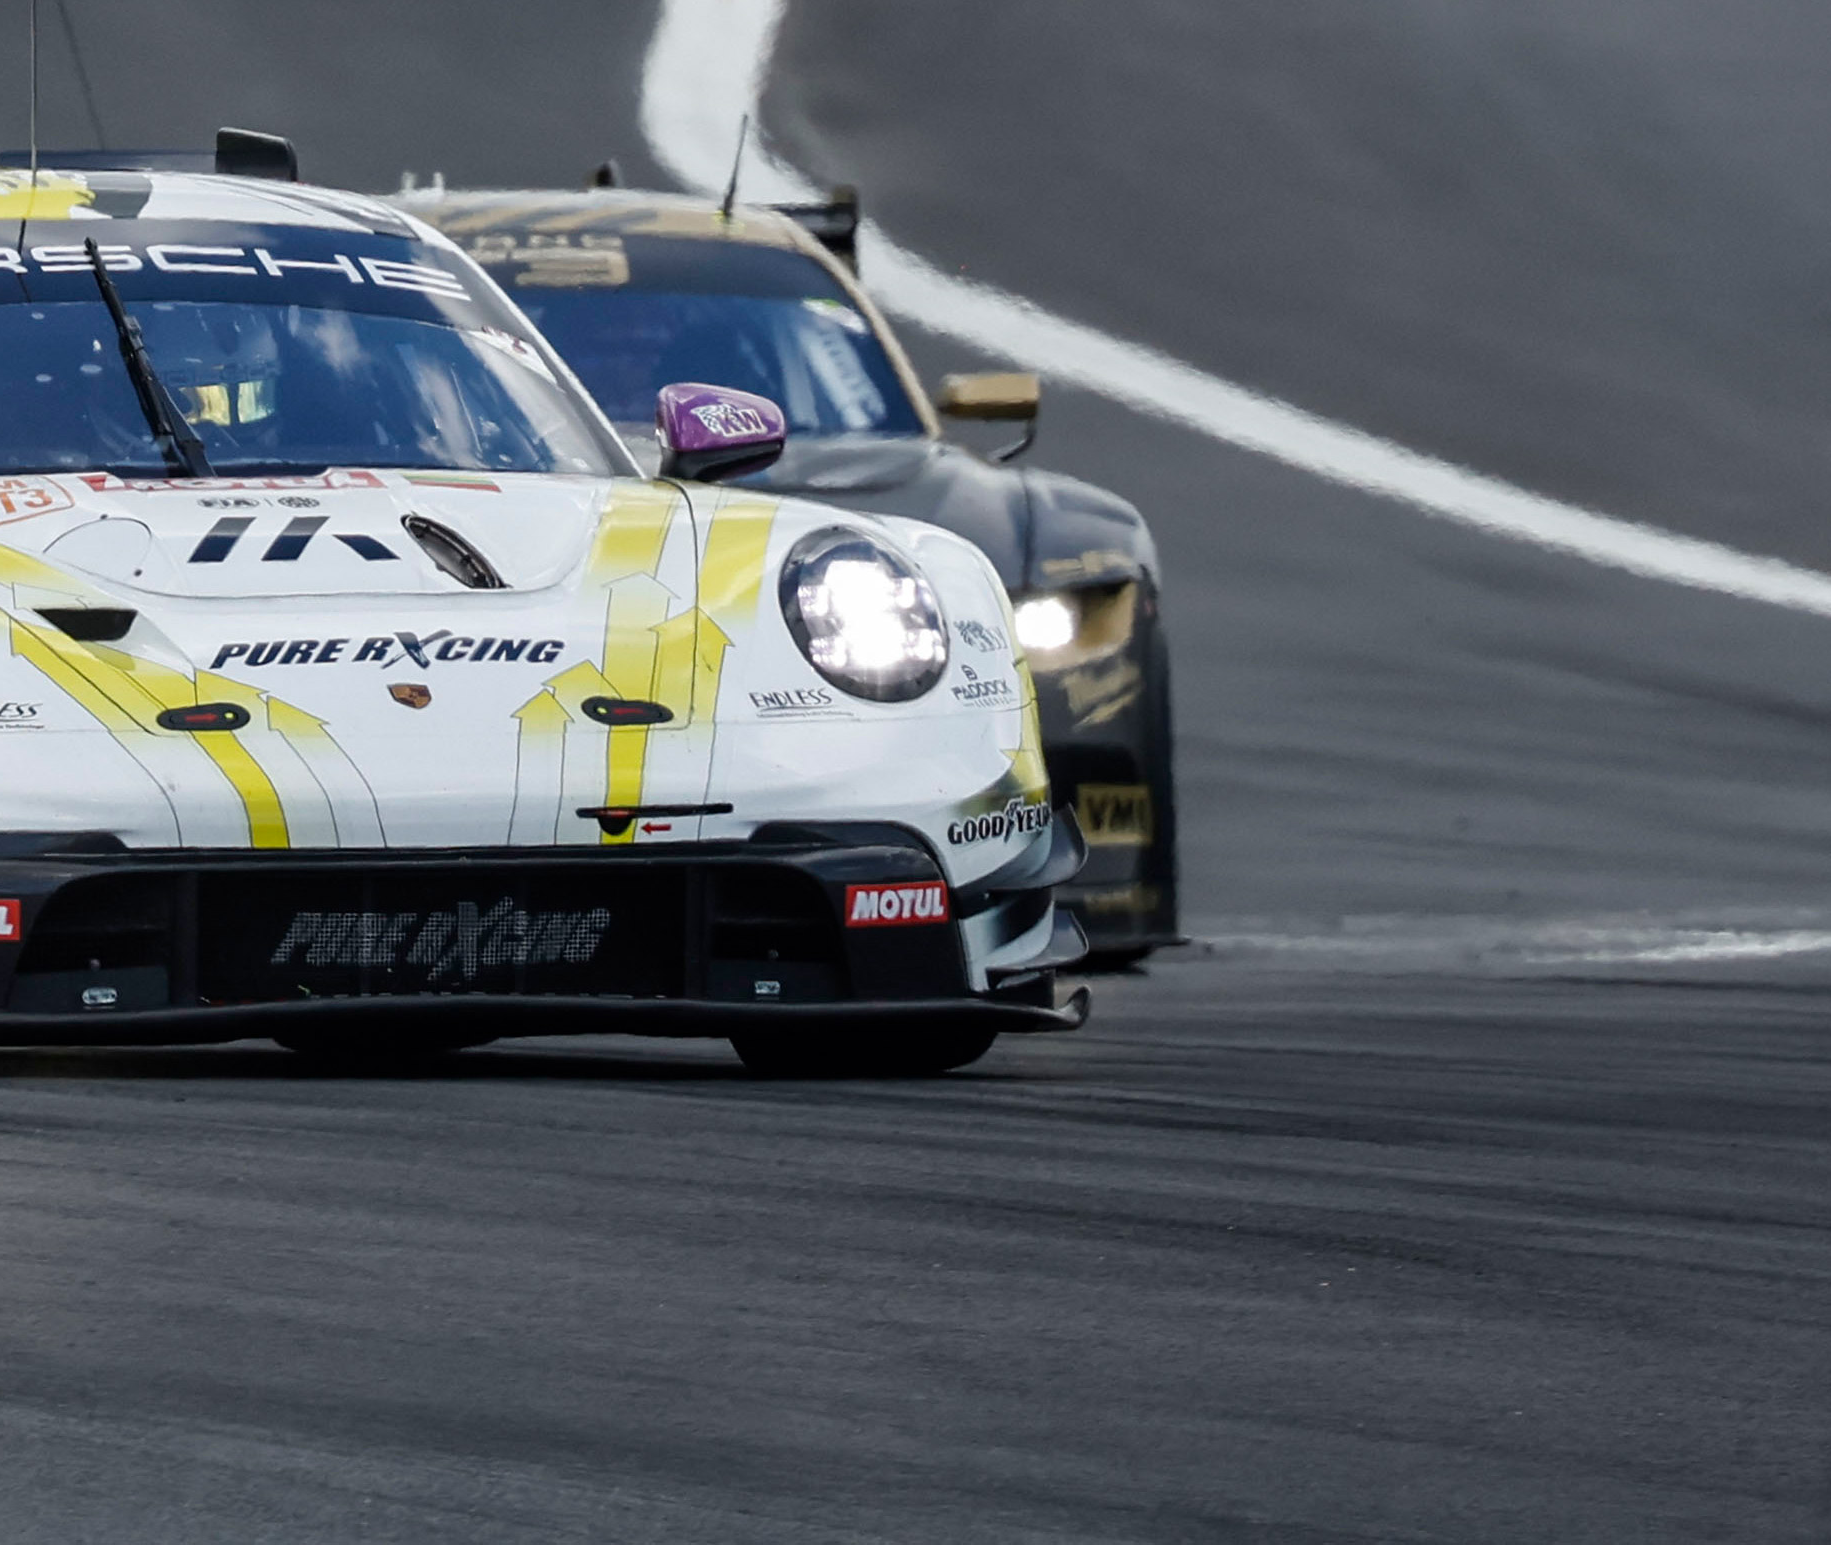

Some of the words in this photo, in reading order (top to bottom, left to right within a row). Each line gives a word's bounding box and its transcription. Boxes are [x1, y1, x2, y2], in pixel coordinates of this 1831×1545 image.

[209, 638, 350, 669] PURE
[352, 629, 565, 669] RXCING
[748, 687, 833, 708] ENDLESS
[851, 888, 945, 922] MOTUL
